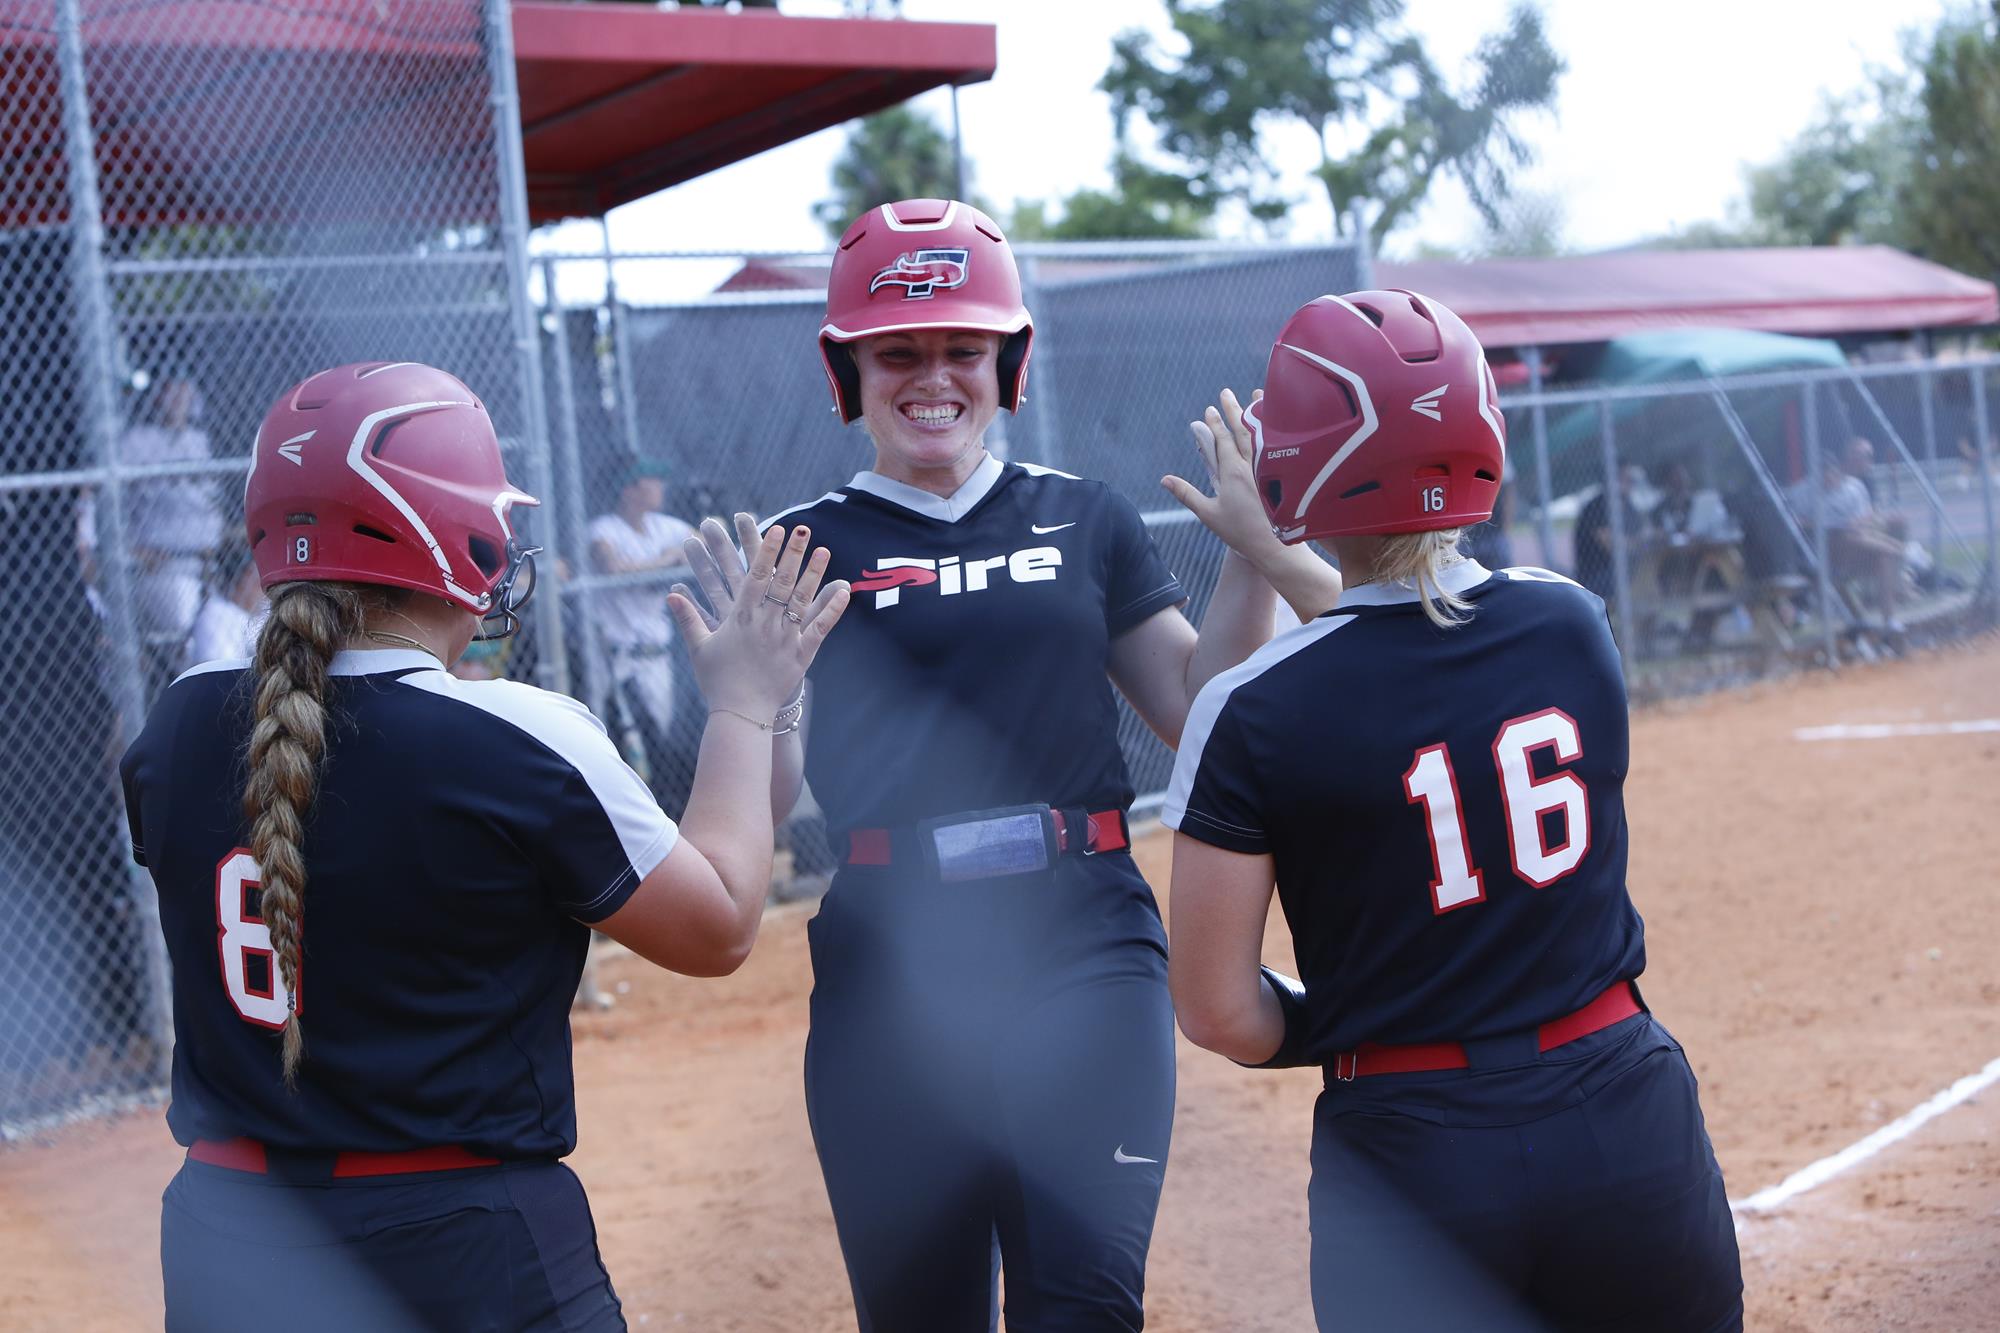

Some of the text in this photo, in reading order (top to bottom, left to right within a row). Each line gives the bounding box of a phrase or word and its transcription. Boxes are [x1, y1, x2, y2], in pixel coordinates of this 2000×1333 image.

[1267, 447, 1300, 460] EASTON
[1421, 486, 1445, 513] 16
[295, 536, 310, 563] 8
[851, 546, 1063, 610] Fire
[1402, 706, 1592, 915] 16
[215, 846, 304, 1031] 8
